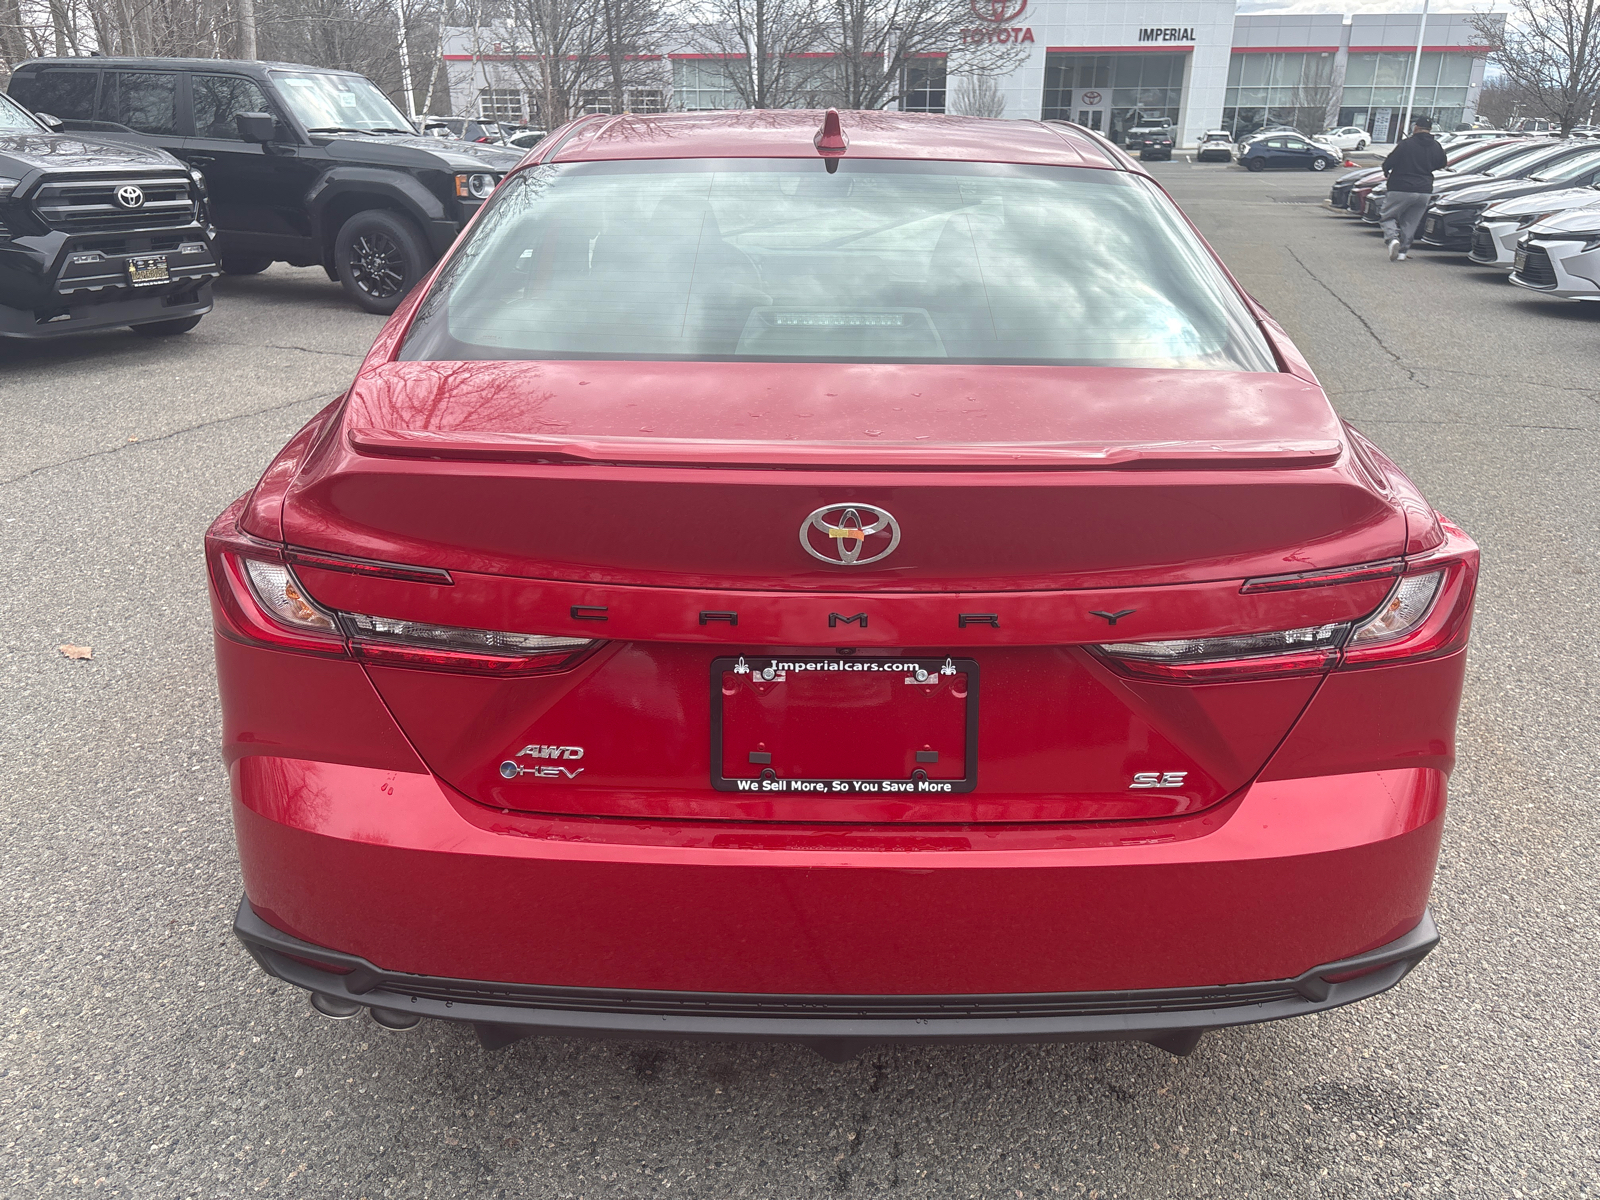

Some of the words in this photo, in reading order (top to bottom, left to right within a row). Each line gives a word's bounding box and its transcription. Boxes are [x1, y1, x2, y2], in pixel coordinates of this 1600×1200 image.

[960, 27, 1035, 44] TOYOTA
[1138, 27, 1196, 42] IMPERIAL
[570, 605, 1137, 628] CAMRY
[770, 659, 920, 673] Imperialcars.com
[515, 744, 584, 760] AWD
[519, 764, 585, 779] HEV
[737, 780, 759, 791] We
[762, 780, 787, 792] Sell
[791, 780, 828, 793] More,
[832, 781, 849, 792] So
[853, 781, 878, 792] You
[882, 782, 914, 792] Save
[918, 782, 952, 793] More
[1128, 771, 1188, 789] SE
